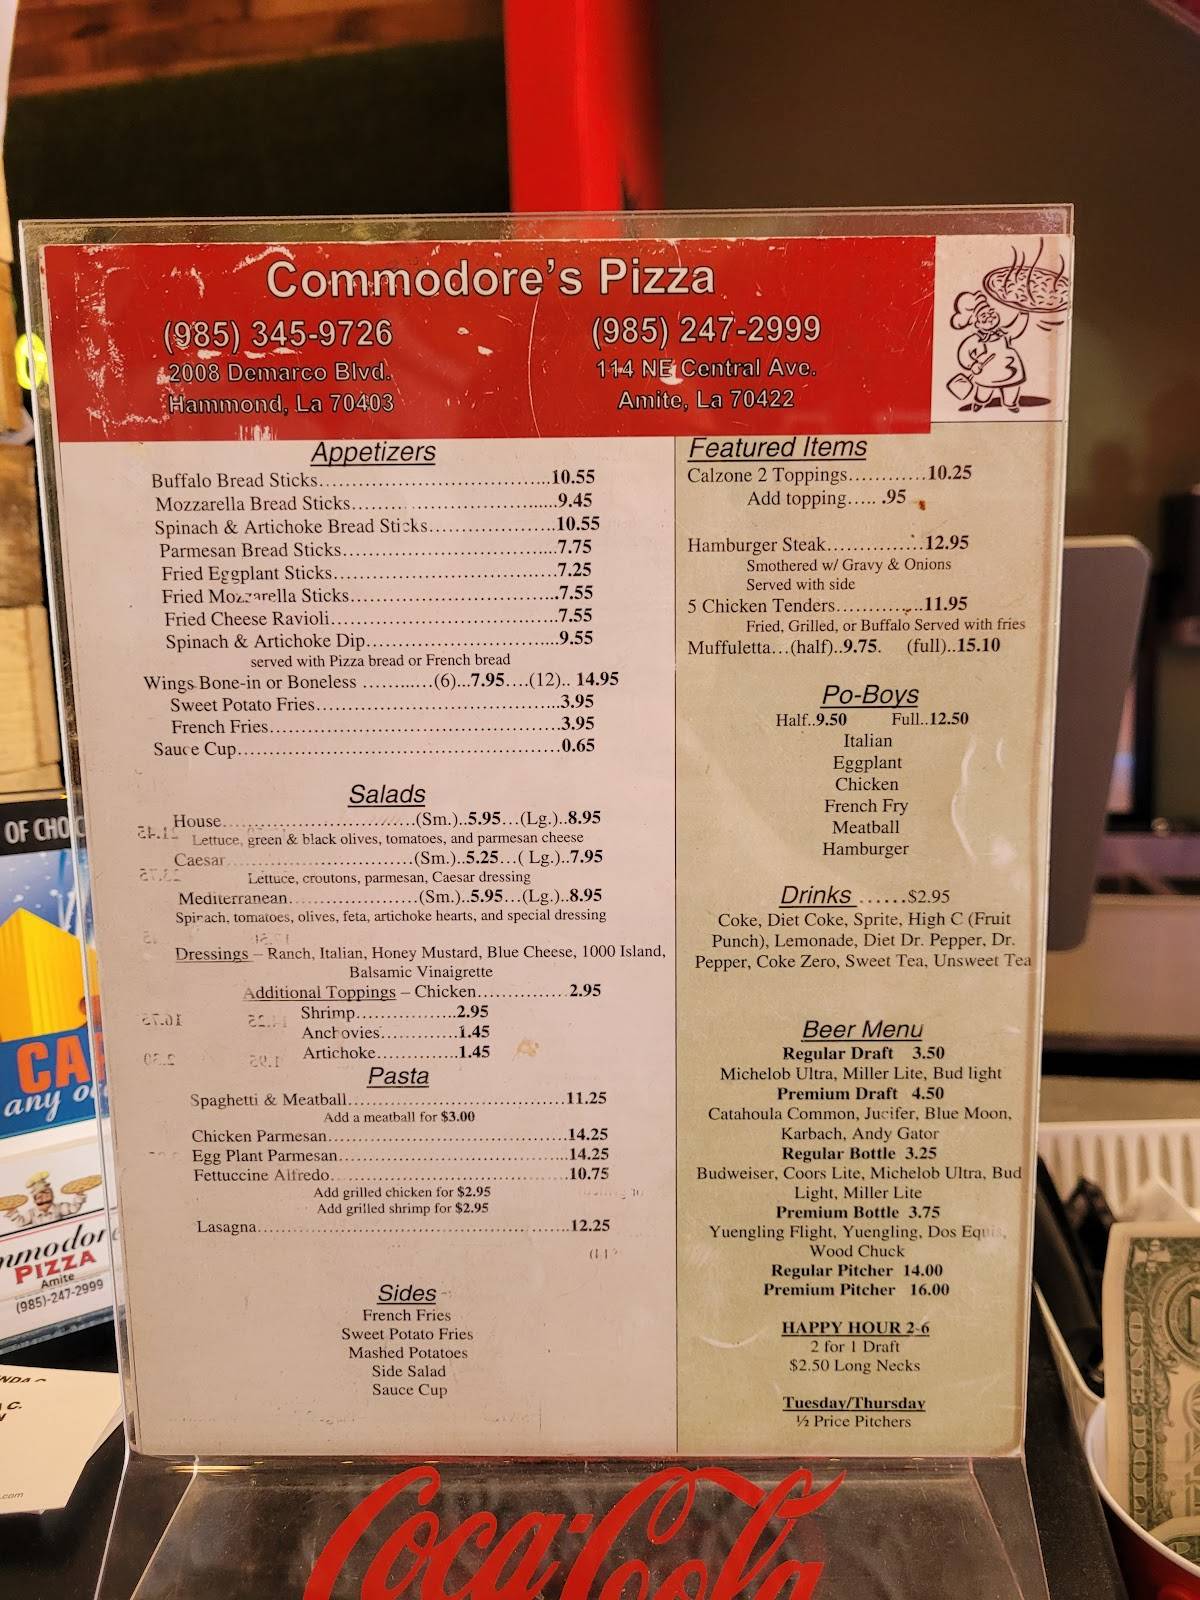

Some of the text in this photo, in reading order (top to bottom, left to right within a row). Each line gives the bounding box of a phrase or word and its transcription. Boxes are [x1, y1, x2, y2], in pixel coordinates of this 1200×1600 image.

[600, 257, 715, 296] Pizza
[162, 319, 394, 354] (985) 345-9726
[591, 315, 822, 350] (985) 247-2999
[168, 361, 392, 384] 2008 Demarco Blvd.
[597, 358, 817, 380] 114 NE Central Ave.
[167, 394, 394, 416] Hammond, La 70403
[618, 390, 795, 411] Amite, La 70422
[309, 441, 437, 468] Appetizers
[686, 436, 868, 463] Featured Items
[151, 472, 265, 489] Buffalo Bread
[552, 469, 595, 485] 10.55
[687, 467, 768, 483] Calzone 2
[928, 464, 972, 481] 10.25
[155, 495, 297, 512] Mozzarella Bread
[558, 492, 592, 508] 9.45
[155, 518, 375, 540] Spinach & Artichoke Bread
[925, 534, 969, 551] 12.95
[746, 557, 952, 574] Smothered w/ Gravy & Onions
[161, 565, 280, 585] Fried Eggplant
[746, 577, 856, 592] Served with side
[250, 652, 511, 668] served with Pizza bread or French bread
[143, 674, 357, 695] Wings Bone-in or Boneless
[576, 671, 619, 687] 14.95
[170, 697, 272, 713] Sweet Potato
[819, 684, 920, 710] Po-Boys
[843, 733, 893, 748] Italian
[832, 755, 903, 774] Eggplant
[835, 776, 899, 792] Chicken
[349, 784, 426, 804] Salads
[824, 798, 909, 816] French Fry
[4, 820, 29, 844] OF
[832, 819, 900, 835] Meatball
[822, 841, 910, 859] Hamburger
[248, 870, 531, 887] Lettuce, croutons, parmesan, Caesar dressing
[780, 885, 852, 904] Drinks
[718, 911, 1011, 930] Coke, Diet Coke, Sprite, High C (Fruit
[266, 944, 666, 962] Ranch, Italian, Honey Mustard, Blue Cheese, 1000 Island,
[349, 965, 494, 982] Balsamic Vinaigrette
[802, 1019, 924, 1039] Beer Menu
[782, 1046, 945, 1064] Regular Draft 3.50
[366, 1066, 430, 1089] Pasta
[720, 1066, 1002, 1083] Michelob Ultra, Miller Lite, Bud light
[190, 1093, 277, 1110] Spaghetti &
[567, 1091, 607, 1105] 11.25
[777, 1086, 945, 1101] Premium Draft 4.50
[4, 1090, 61, 1122] any
[323, 1109, 476, 1124] Add a meatball for $3.00
[192, 1129, 252, 1143] Chicken
[568, 1127, 608, 1141] 14.25
[192, 1149, 263, 1166] Egg Plant
[571, 1219, 610, 1232] 12.25
[15, 1250, 96, 1285] PIZZA
[771, 1263, 943, 1281] Regular Pitcher 14.00
[41, 1273, 75, 1289] Amite
[16, 1279, 104, 1315] (985)-247-2999
[376, 1284, 437, 1306] Sides
[362, 1308, 451, 1322] French Fries
[341, 1327, 474, 1341] Sweet Potato Fries
[782, 1320, 931, 1335] HAPPY HOUR 2-6
[348, 1345, 468, 1360] Mashed Potatoes
[372, 1364, 446, 1378] Side Salad
[789, 1358, 920, 1375] $2.50 Long Necks
[782, 1396, 926, 1413] Tuesday/Thursday
[814, 1414, 850, 1427] Price
[855, 1415, 912, 1428] Pitchers
